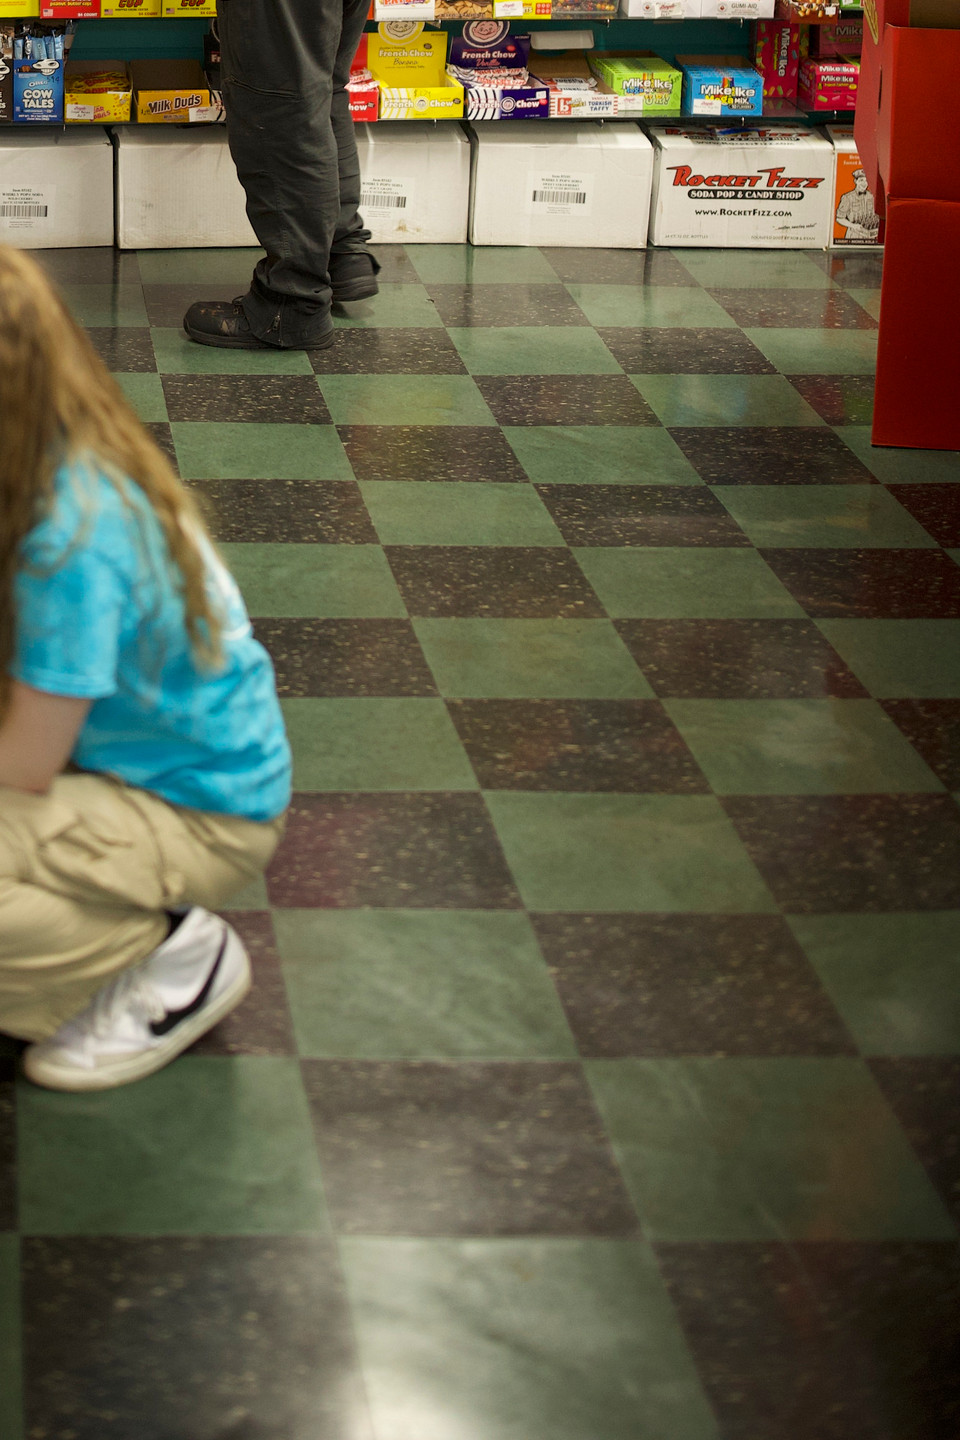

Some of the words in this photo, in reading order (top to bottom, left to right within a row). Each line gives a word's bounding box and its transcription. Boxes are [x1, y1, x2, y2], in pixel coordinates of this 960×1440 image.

[119, 0, 143, 8] CUP
[778, 27, 790, 56] Mike
[461, 51, 491, 59] French
[492, 51, 516, 59] Chew
[778, 57, 788, 77] Ike
[622, 78, 652, 89] Mike
[654, 79, 673, 90] Ike
[820, 75, 841, 83] Mike
[24, 89, 51, 99] COW
[700, 85, 732, 97] Mike
[735, 87, 756, 97] Ike
[22, 99, 54, 109] TALES
[148, 100, 172, 114] Milk
[174, 94, 202, 110] Duds
[471, 101, 500, 109] French
[516, 101, 540, 109] Chew
[776, 192, 803, 200] SHOP
